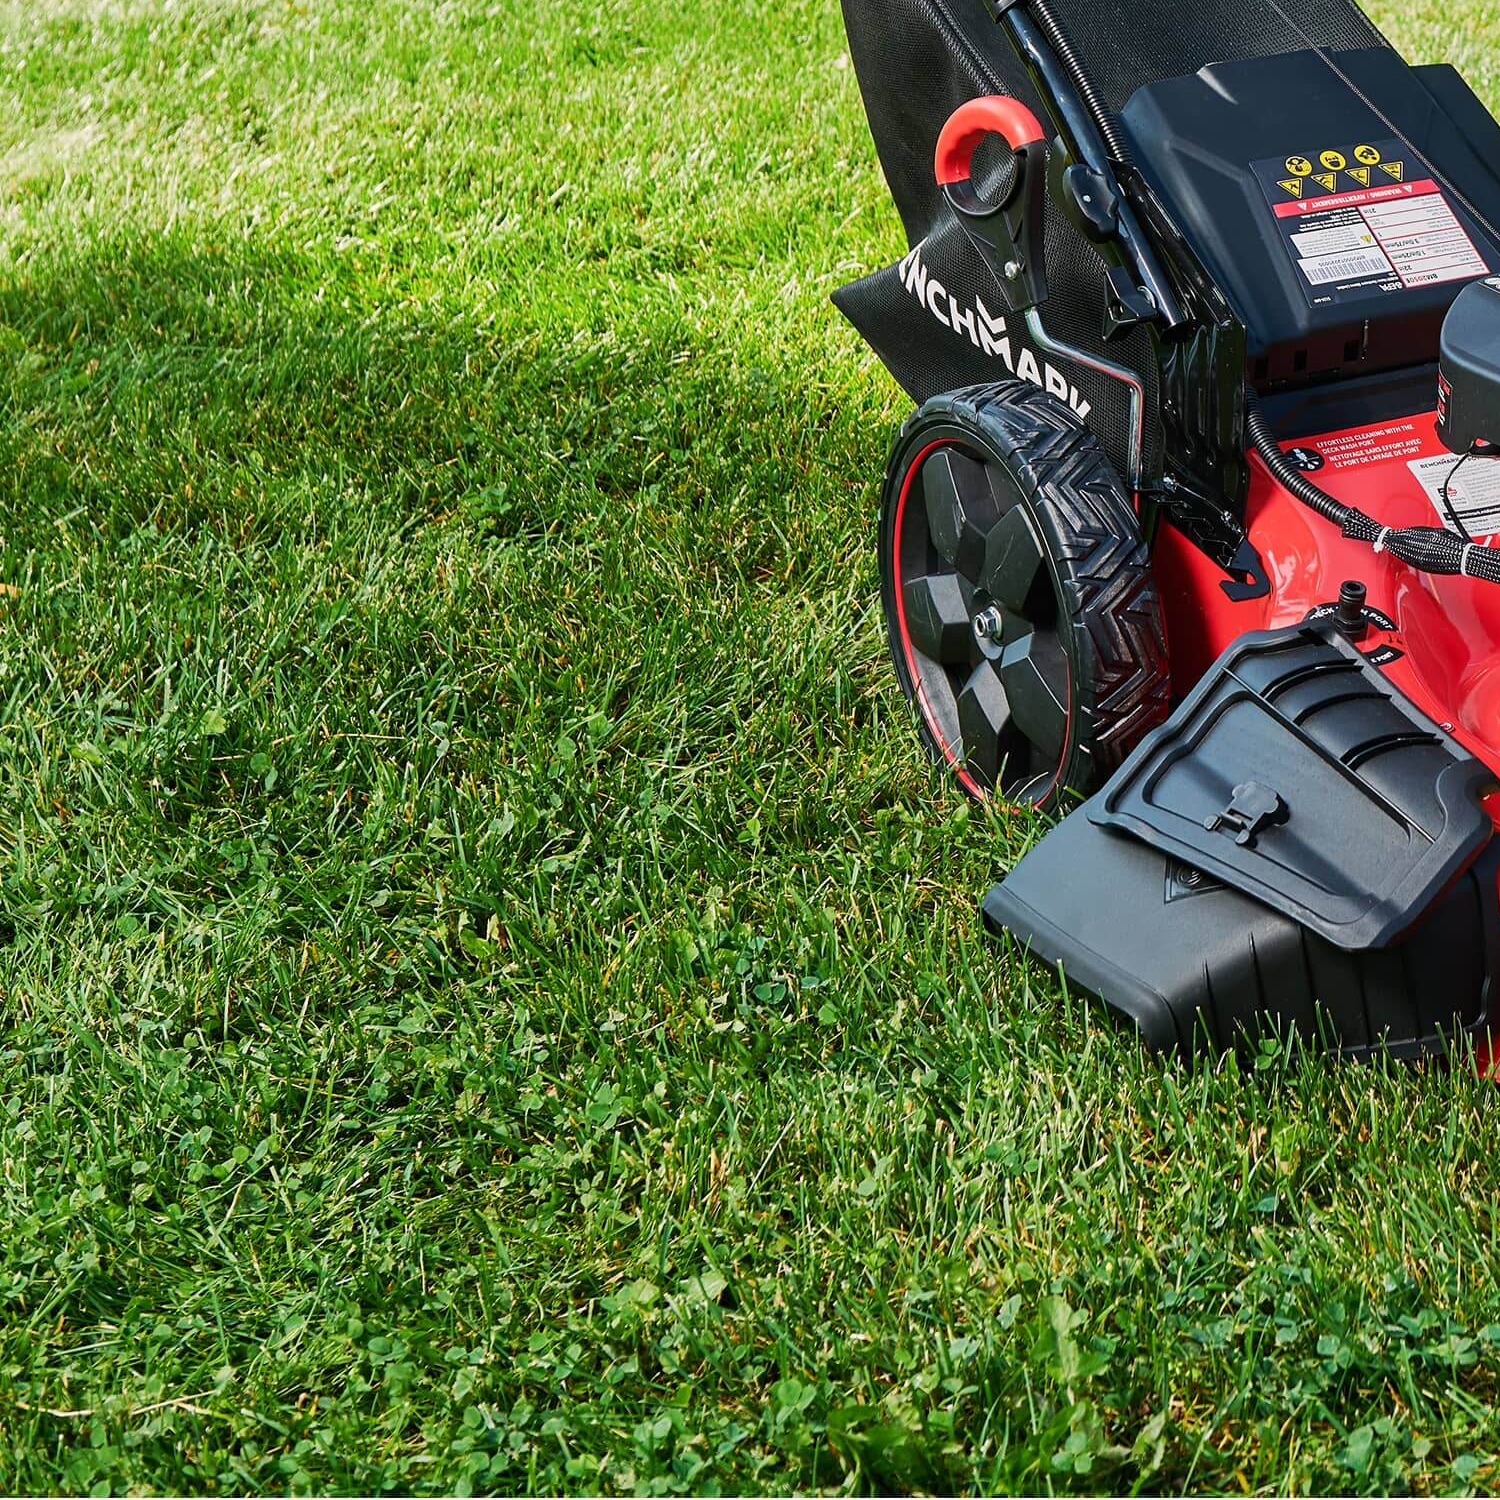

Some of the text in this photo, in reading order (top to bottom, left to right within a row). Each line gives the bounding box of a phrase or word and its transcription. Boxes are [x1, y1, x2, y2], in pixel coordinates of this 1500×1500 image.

[1316, 435, 1354, 449] EFFORTLESS
[1354, 430, 1385, 442] CLEANING
[1384, 426, 1401, 436] WITH
[1322, 439, 1375, 454] DECK WASH PORT
[1329, 438, 1422, 462] NETTOYAGE SANS EFFORT AVEC
[1334, 461, 1343, 469] LE
[1369, 452, 1394, 462] LAVAGE
[1393, 449, 1403, 457] DE
